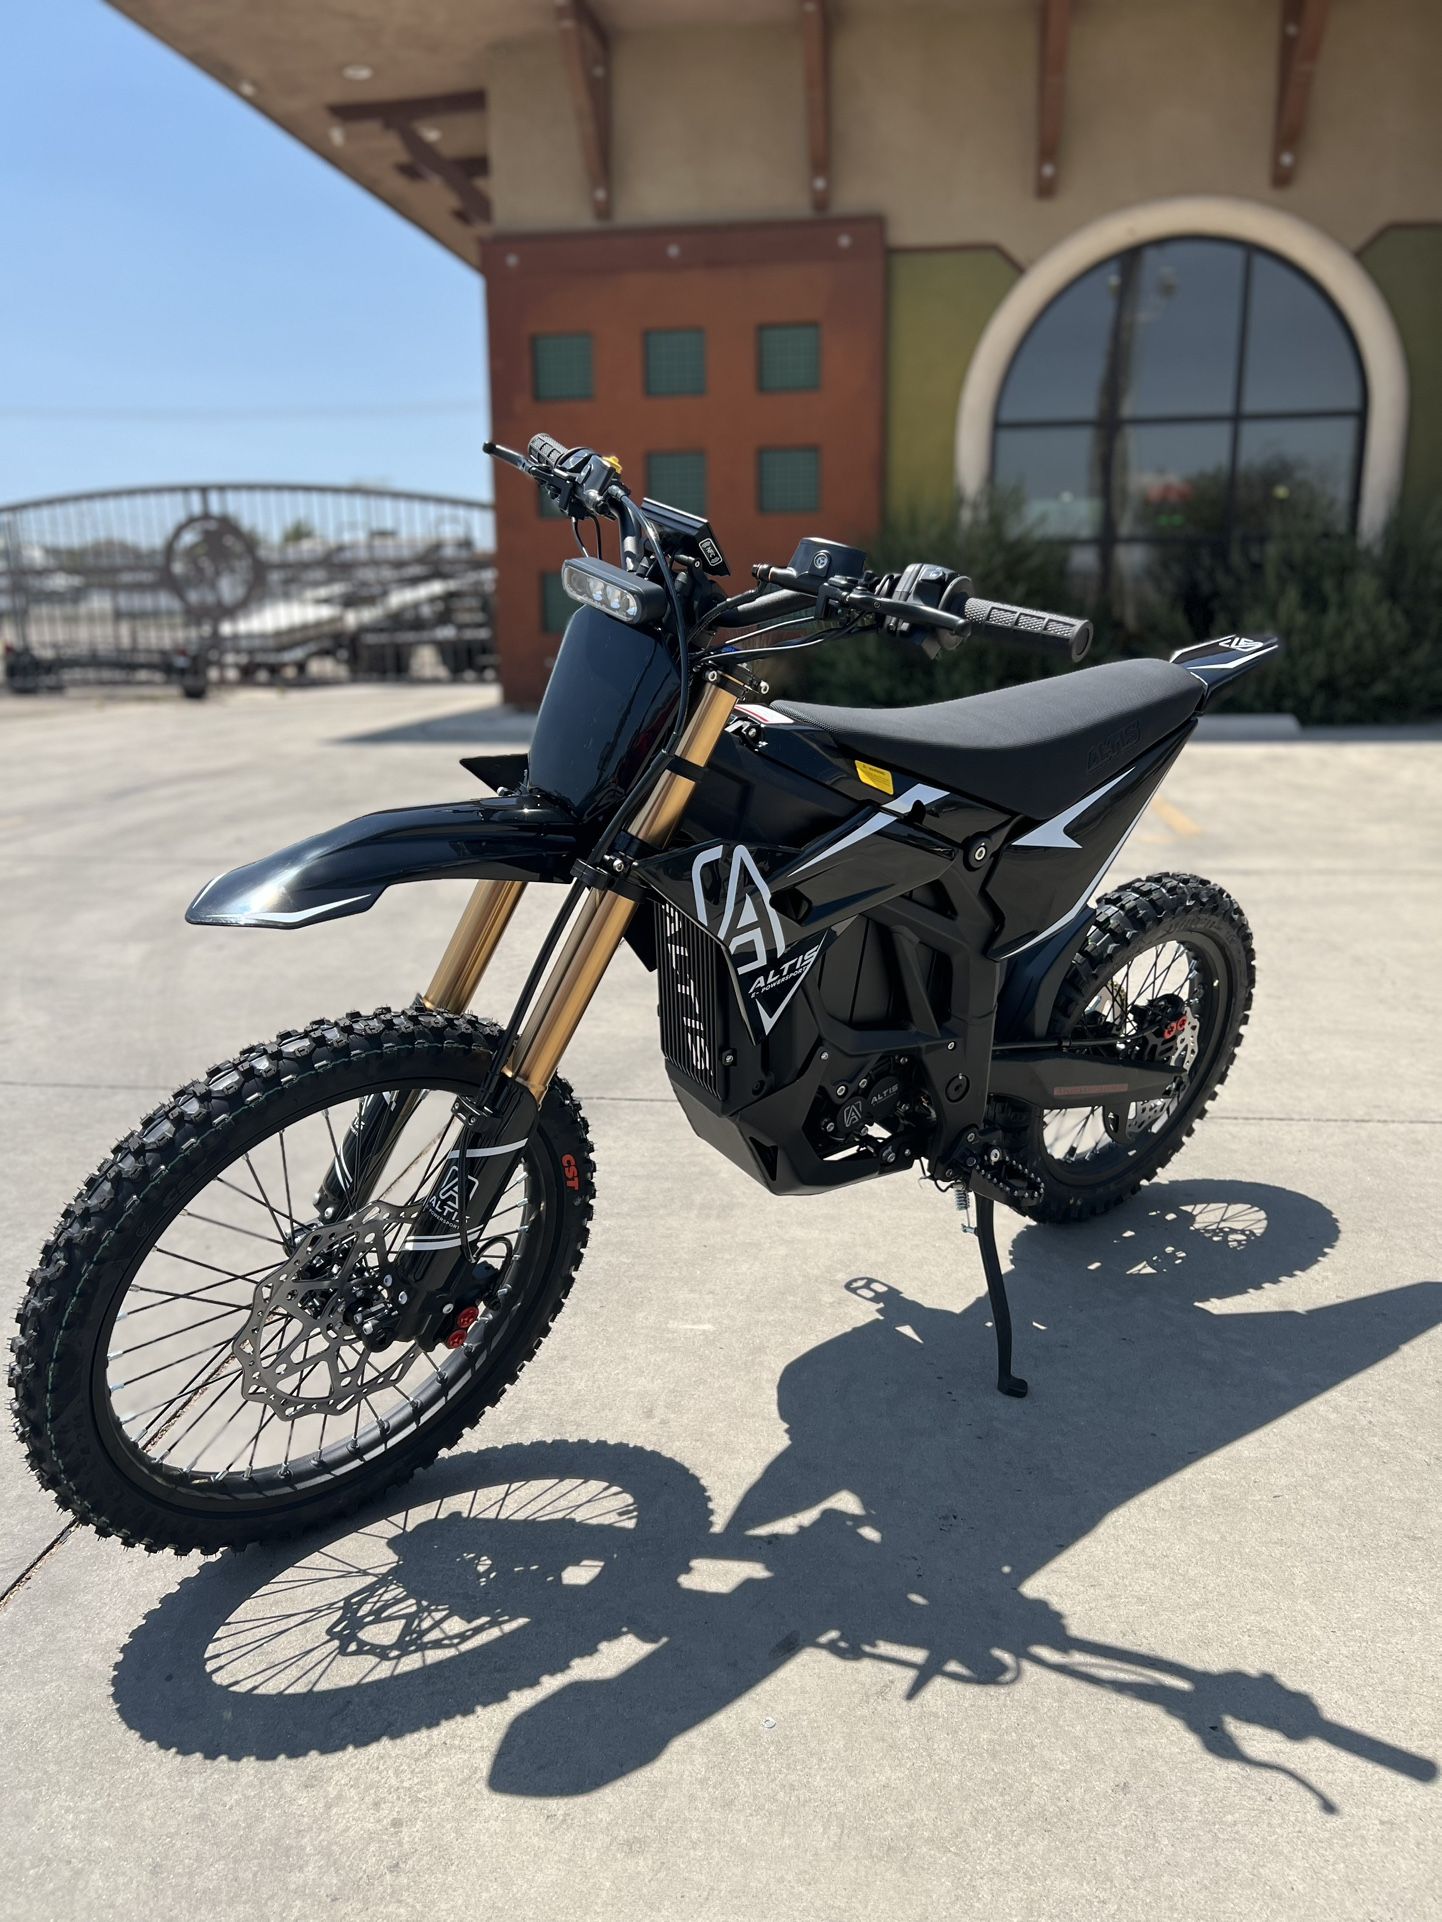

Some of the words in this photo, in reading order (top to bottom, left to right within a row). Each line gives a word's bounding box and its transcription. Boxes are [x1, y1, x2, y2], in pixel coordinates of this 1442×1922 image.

[748, 944, 821, 994] ALTIS
[871, 1083, 898, 1105] ALTIS
[561, 1153, 579, 1190] CST
